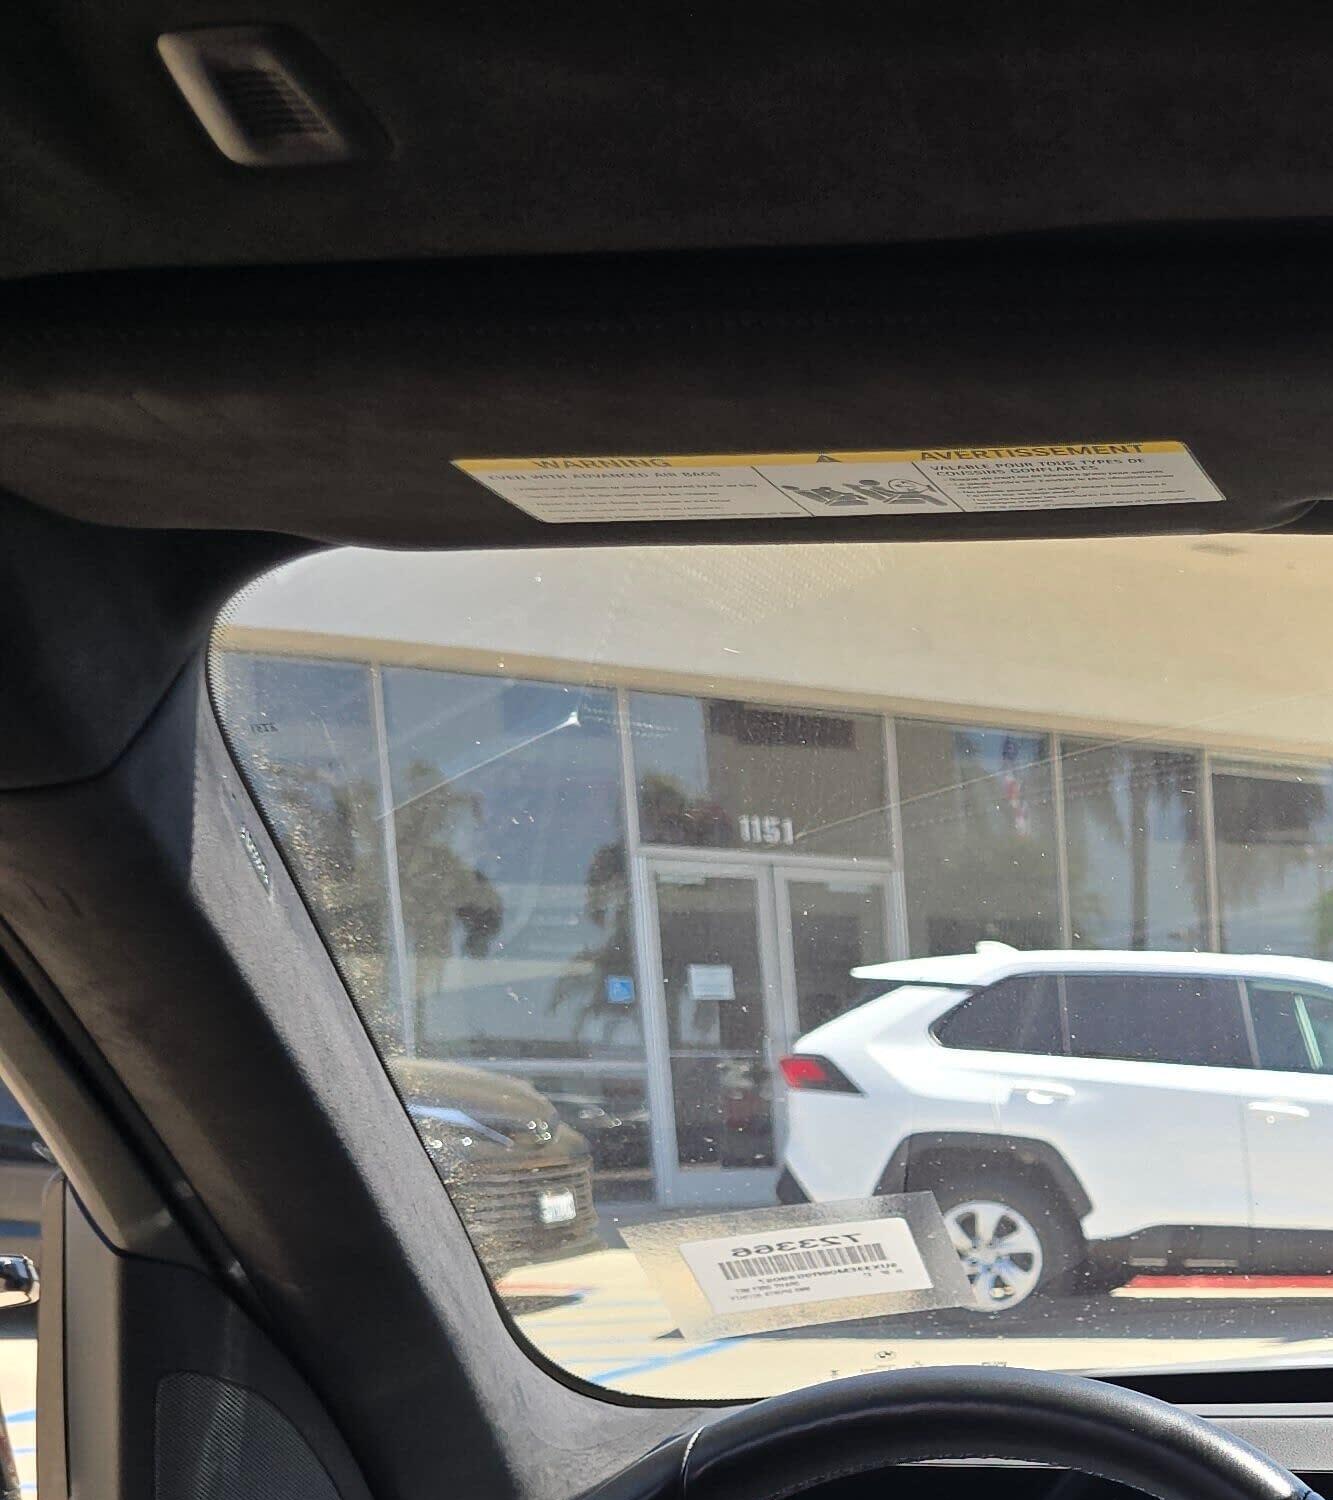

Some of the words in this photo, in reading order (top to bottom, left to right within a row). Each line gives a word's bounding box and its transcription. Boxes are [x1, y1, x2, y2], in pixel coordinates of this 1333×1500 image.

[921, 444, 1144, 461] AVERTISSEMENT
[533, 457, 672, 470] WARNING
[738, 814, 794, 845] 1151
